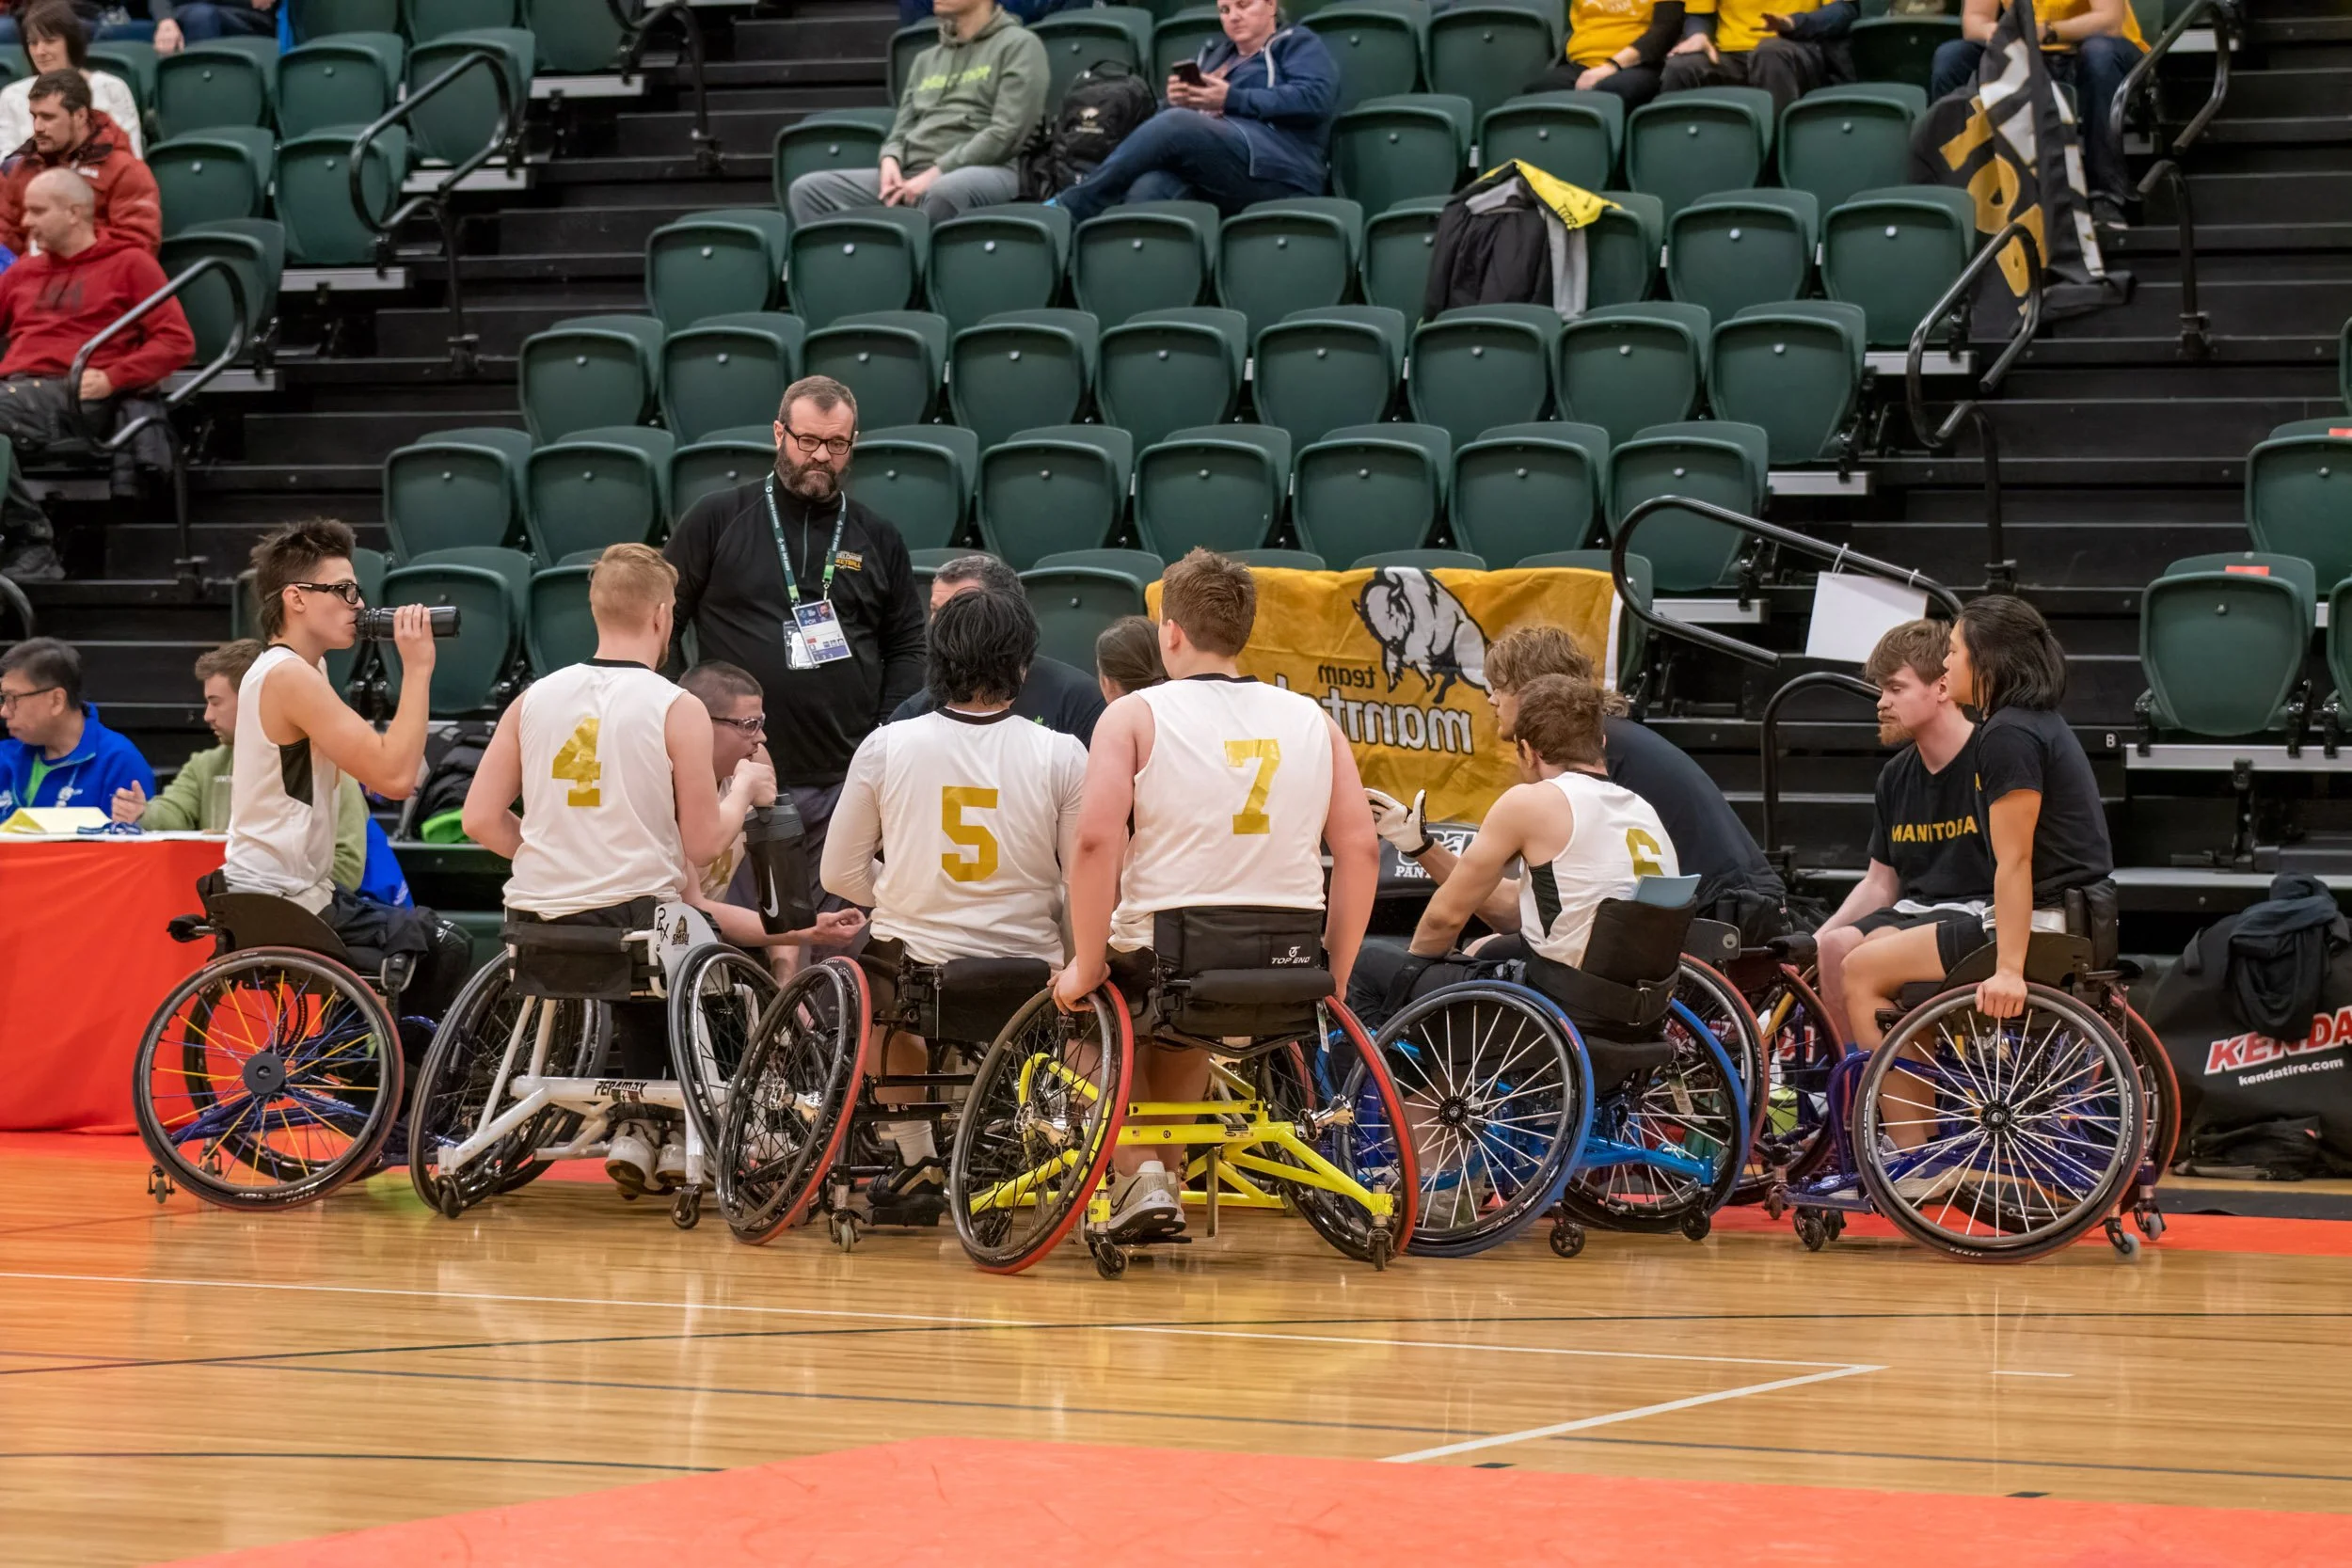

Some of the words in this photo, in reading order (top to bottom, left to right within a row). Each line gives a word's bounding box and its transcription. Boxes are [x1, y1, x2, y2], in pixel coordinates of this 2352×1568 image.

[2106, 733, 2117, 749] B
[551, 717, 601, 807] 4
[1224, 738, 1281, 834] 7
[942, 786, 998, 881] 5
[1394, 865, 1432, 879] PAN
[1626, 828, 1664, 883] 6
[1293, 956, 1311, 964] END
[2237, 1058, 2344, 1086] kendatire.com
